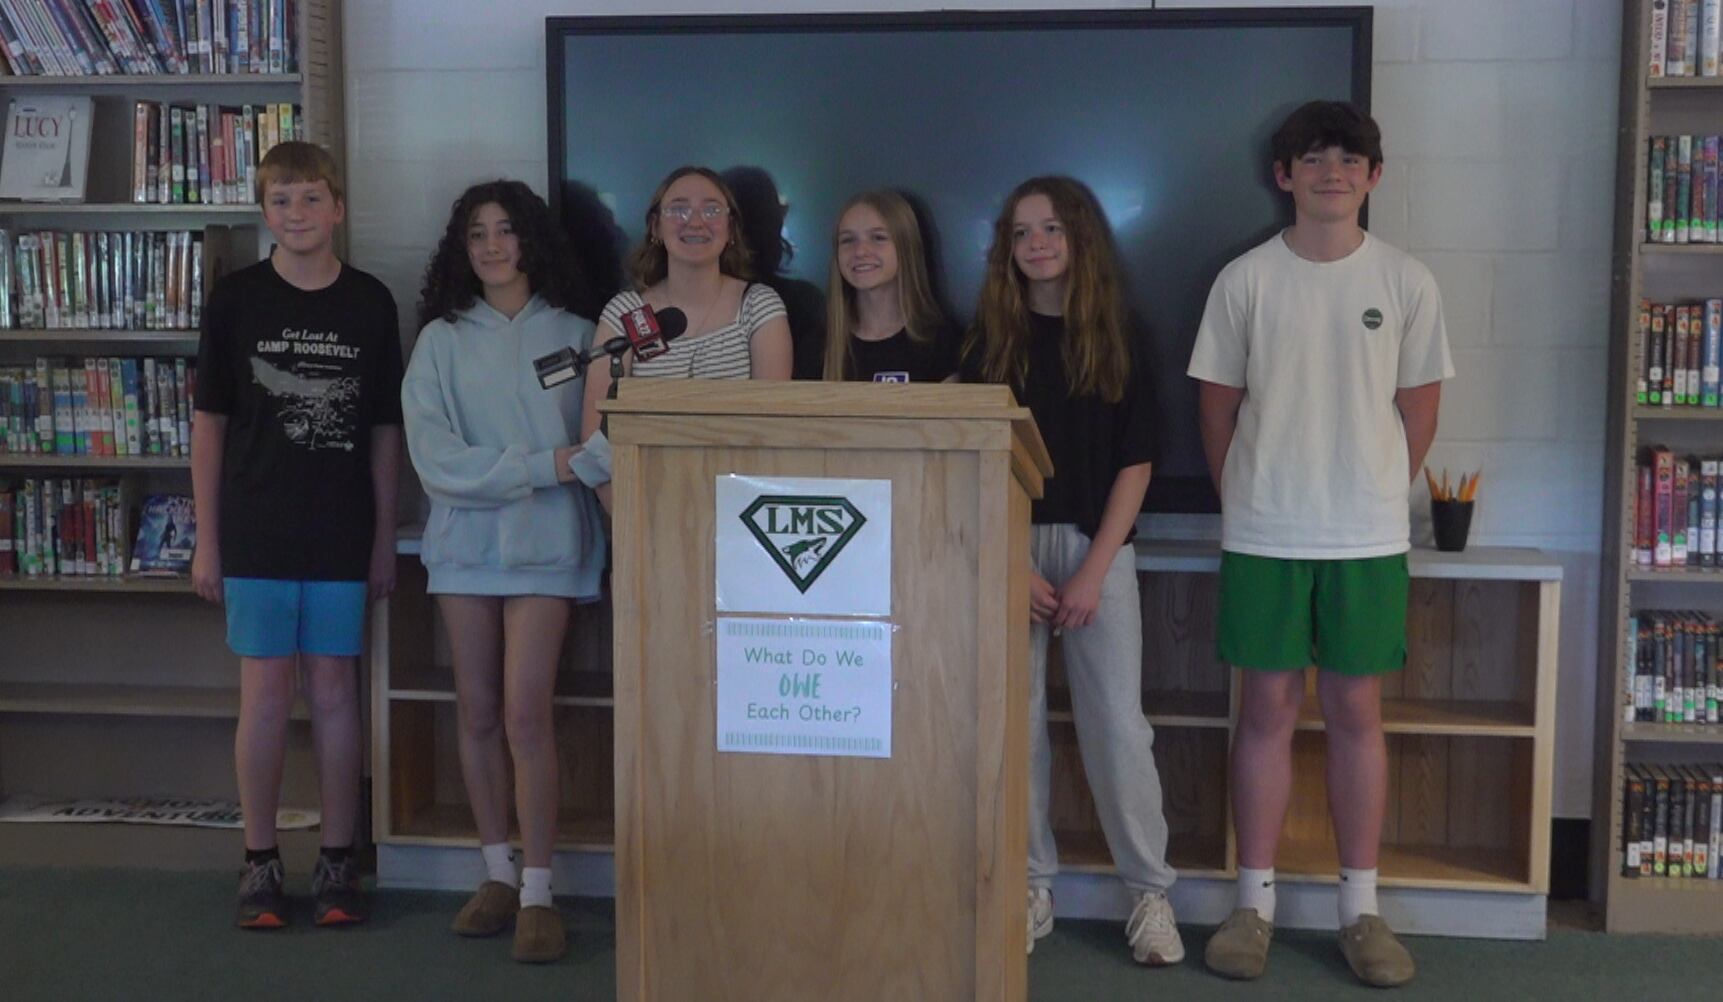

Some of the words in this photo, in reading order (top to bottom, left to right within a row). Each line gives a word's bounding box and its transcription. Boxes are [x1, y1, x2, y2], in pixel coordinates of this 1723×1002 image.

[14, 114, 63, 137] LUCY
[282, 328, 300, 340] Get
[301, 329, 324, 340] Lost
[325, 332, 338, 342] At
[257, 341, 290, 353] CAMP
[294, 343, 360, 358] ROOSEVELT
[766, 507, 844, 535] LMS
[744, 647, 793, 665] What
[802, 649, 827, 666] Do
[836, 650, 864, 667] We
[779, 672, 823, 699] OWE
[747, 703, 790, 720] Each
[799, 704, 861, 722] Other?
